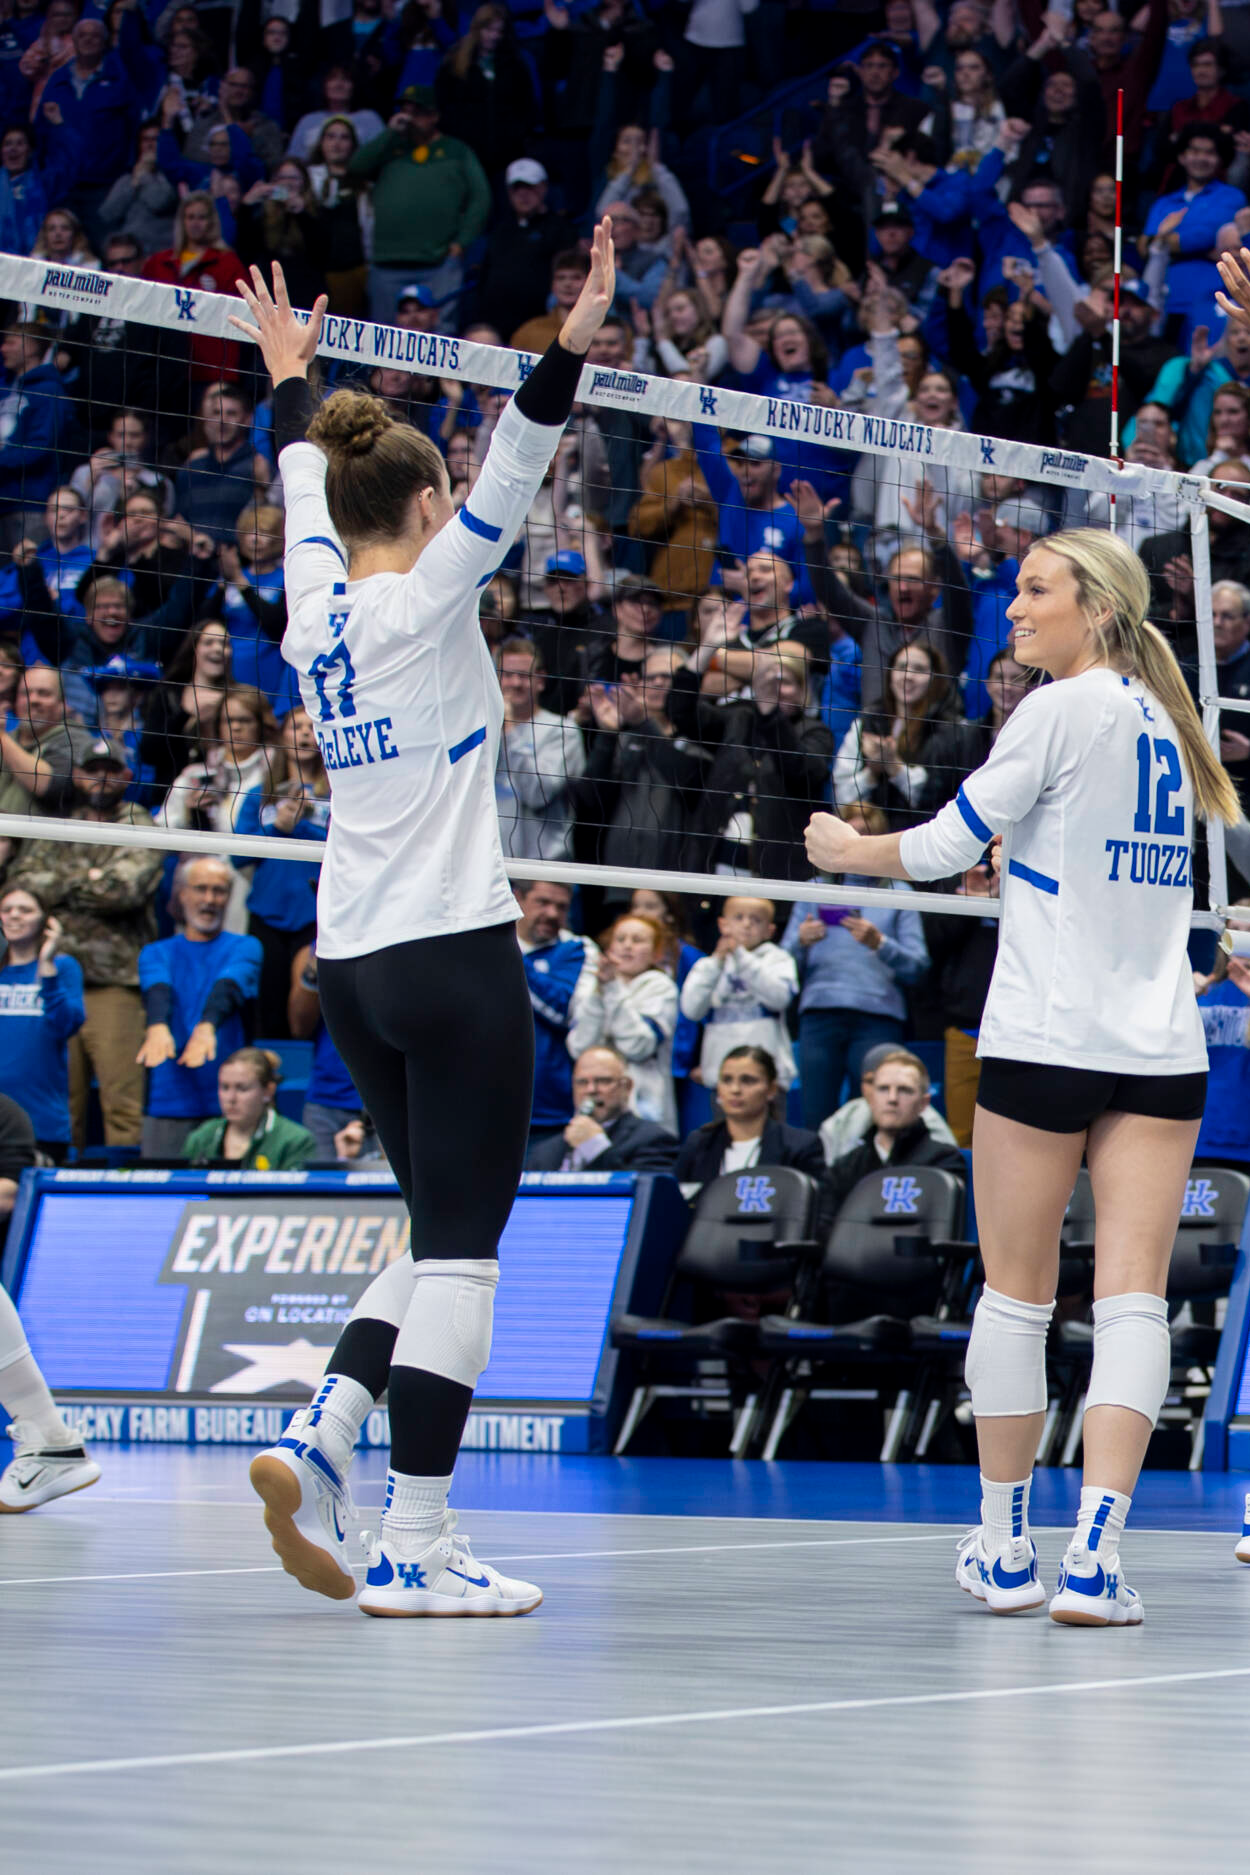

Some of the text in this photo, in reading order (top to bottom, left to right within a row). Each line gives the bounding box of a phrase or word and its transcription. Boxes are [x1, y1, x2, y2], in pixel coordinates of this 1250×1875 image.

[41, 267, 113, 297] paul miller
[373, 324, 460, 371] WILDCATS
[590, 371, 649, 395] paul miller
[766, 399, 935, 455] KENTUCKY WILDCATS
[1133, 732, 1185, 836] 12
[172, 1214, 411, 1274] EXPERIEN
[129, 1407, 189, 1441] FARM
[194, 1408, 284, 1442] BUREAU
[396, 1562, 427, 1589] UK
